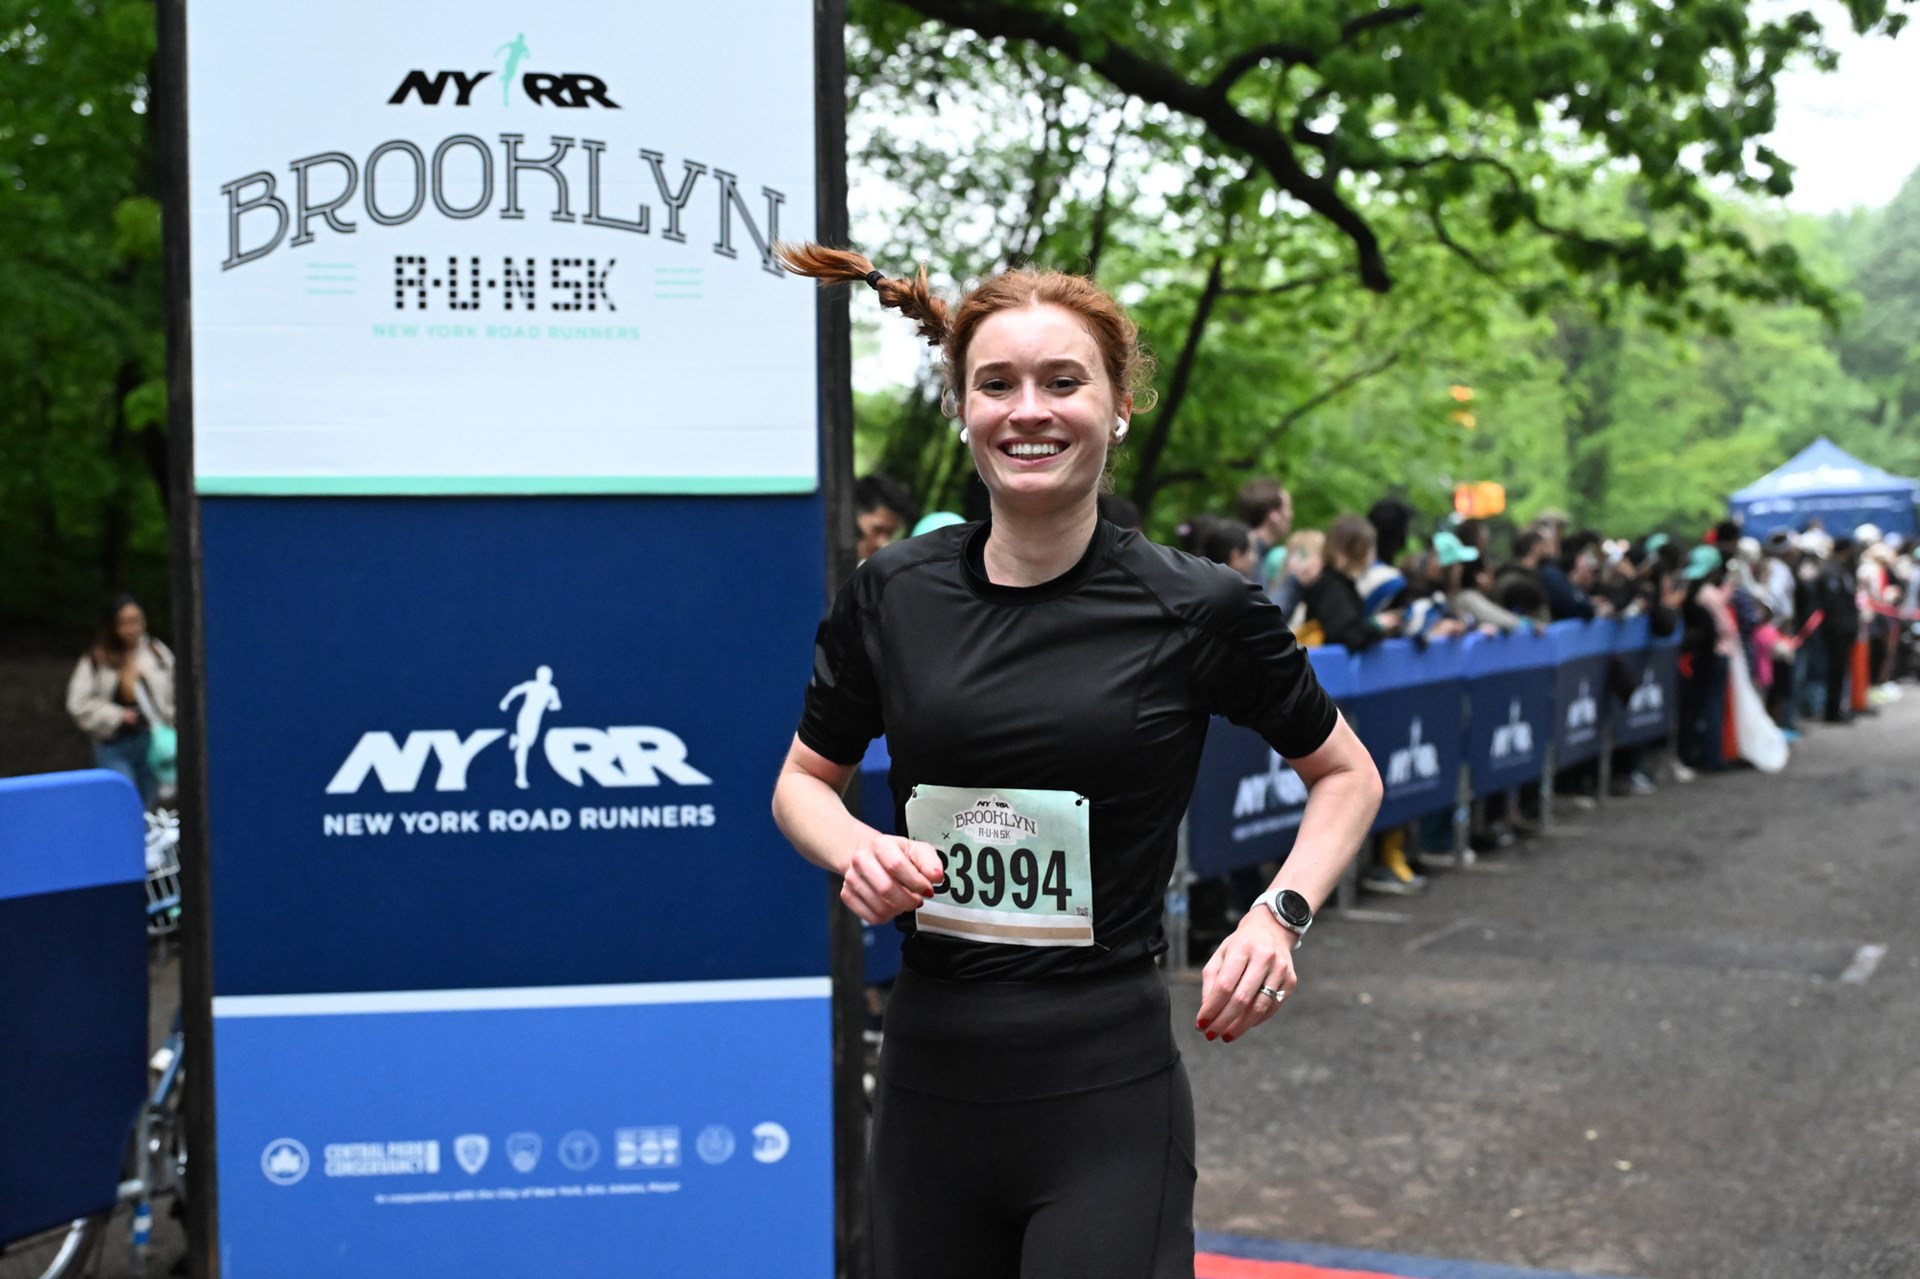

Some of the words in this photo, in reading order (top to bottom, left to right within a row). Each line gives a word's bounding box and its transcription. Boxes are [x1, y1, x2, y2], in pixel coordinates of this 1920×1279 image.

[221, 133, 785, 279] BROOKLYN
[372, 324, 418, 338] NEW
[426, 325, 477, 338] YORK
[485, 326, 541, 339] ROAD
[547, 326, 640, 340] RUNNERS
[323, 814, 394, 836] NEW
[400, 811, 480, 834] YORK
[489, 809, 572, 832] ROAD
[580, 804, 716, 829] RUNNERS
[954, 810, 1037, 835] BROOKLYN
